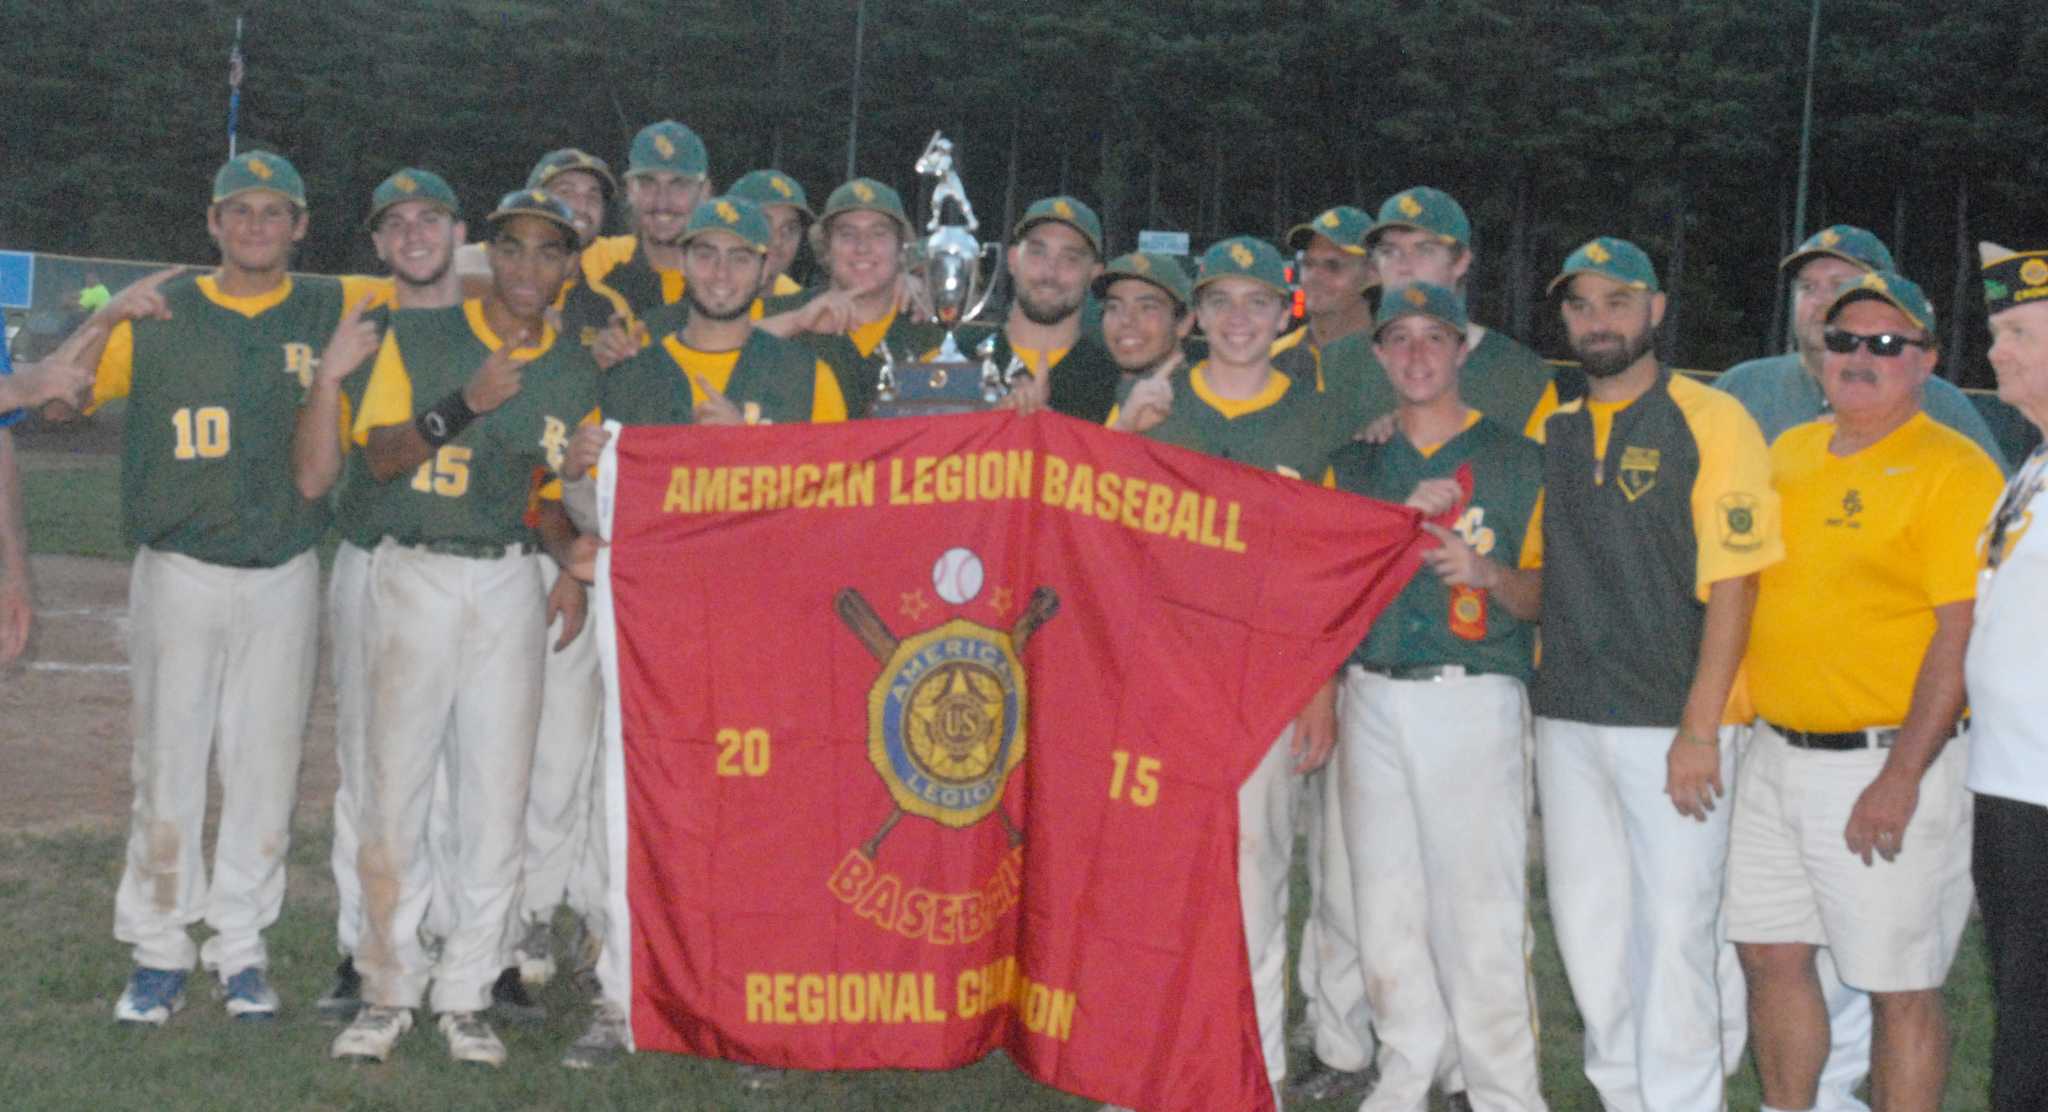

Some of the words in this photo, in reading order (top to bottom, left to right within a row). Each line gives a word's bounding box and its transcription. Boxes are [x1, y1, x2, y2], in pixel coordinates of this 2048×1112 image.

[172, 407, 230, 459] 10
[411, 445, 472, 497] 15
[662, 460, 877, 514] AMERICAN
[889, 450, 1035, 506] LEGION
[1041, 455, 1247, 553] BASEBALL
[946, 710, 977, 736] US
[716, 728, 770, 776] 20
[908, 775, 996, 806] LEGIO
[1109, 750, 1162, 807] 15
[746, 972, 947, 1024] REGIONAL
